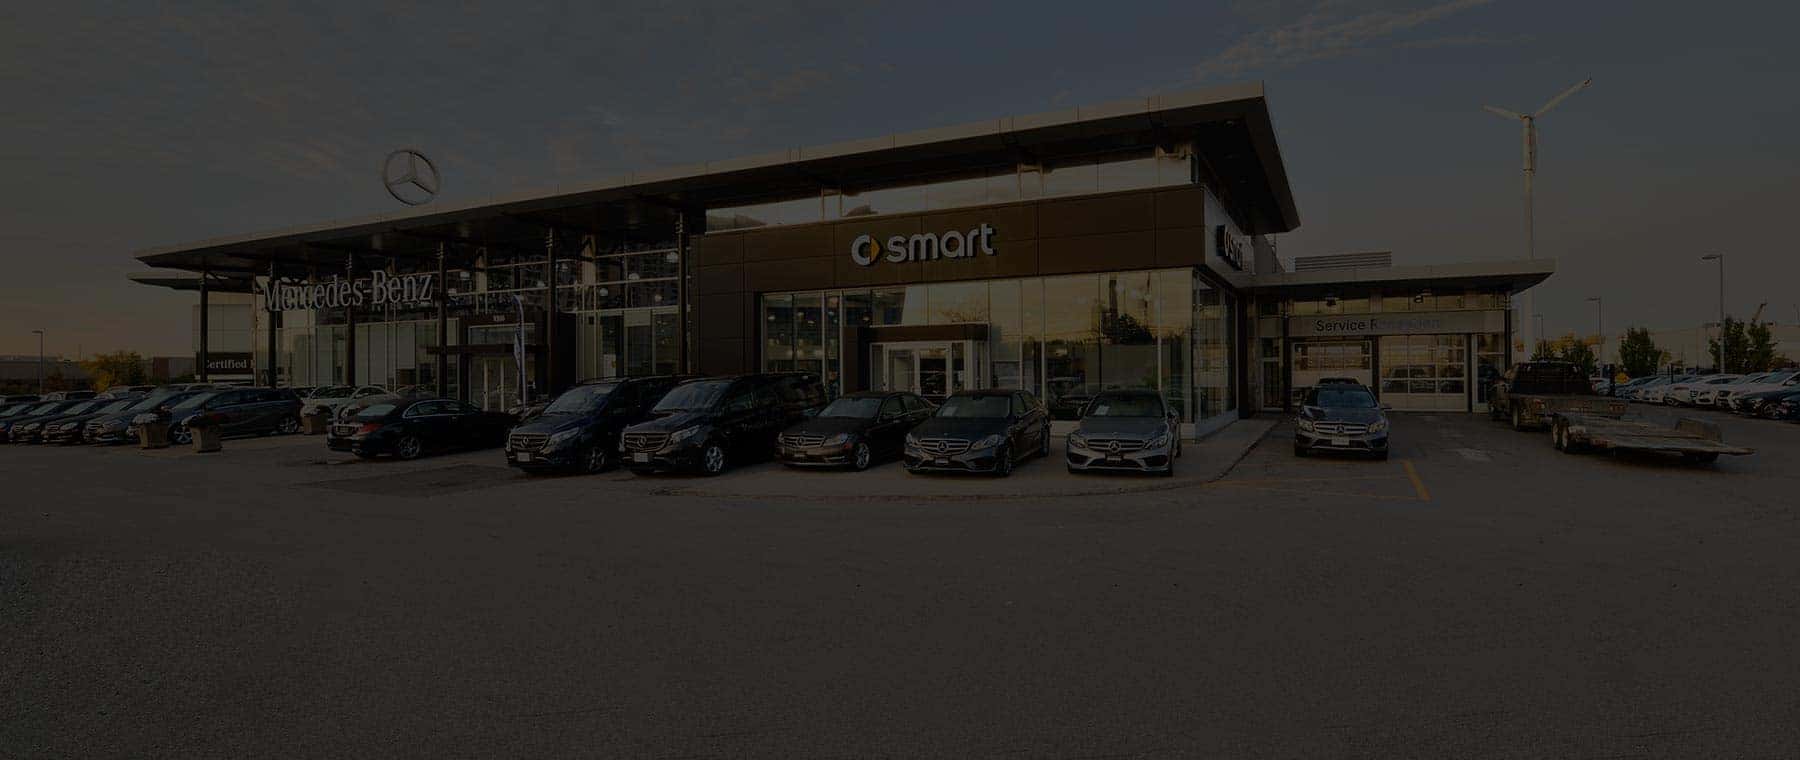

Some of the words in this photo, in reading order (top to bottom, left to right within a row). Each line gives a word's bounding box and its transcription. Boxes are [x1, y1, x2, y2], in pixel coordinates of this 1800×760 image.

[886, 223, 994, 263] smart
[263, 269, 433, 312] Mercedes-Benz
[1315, 319, 1366, 332] Service
